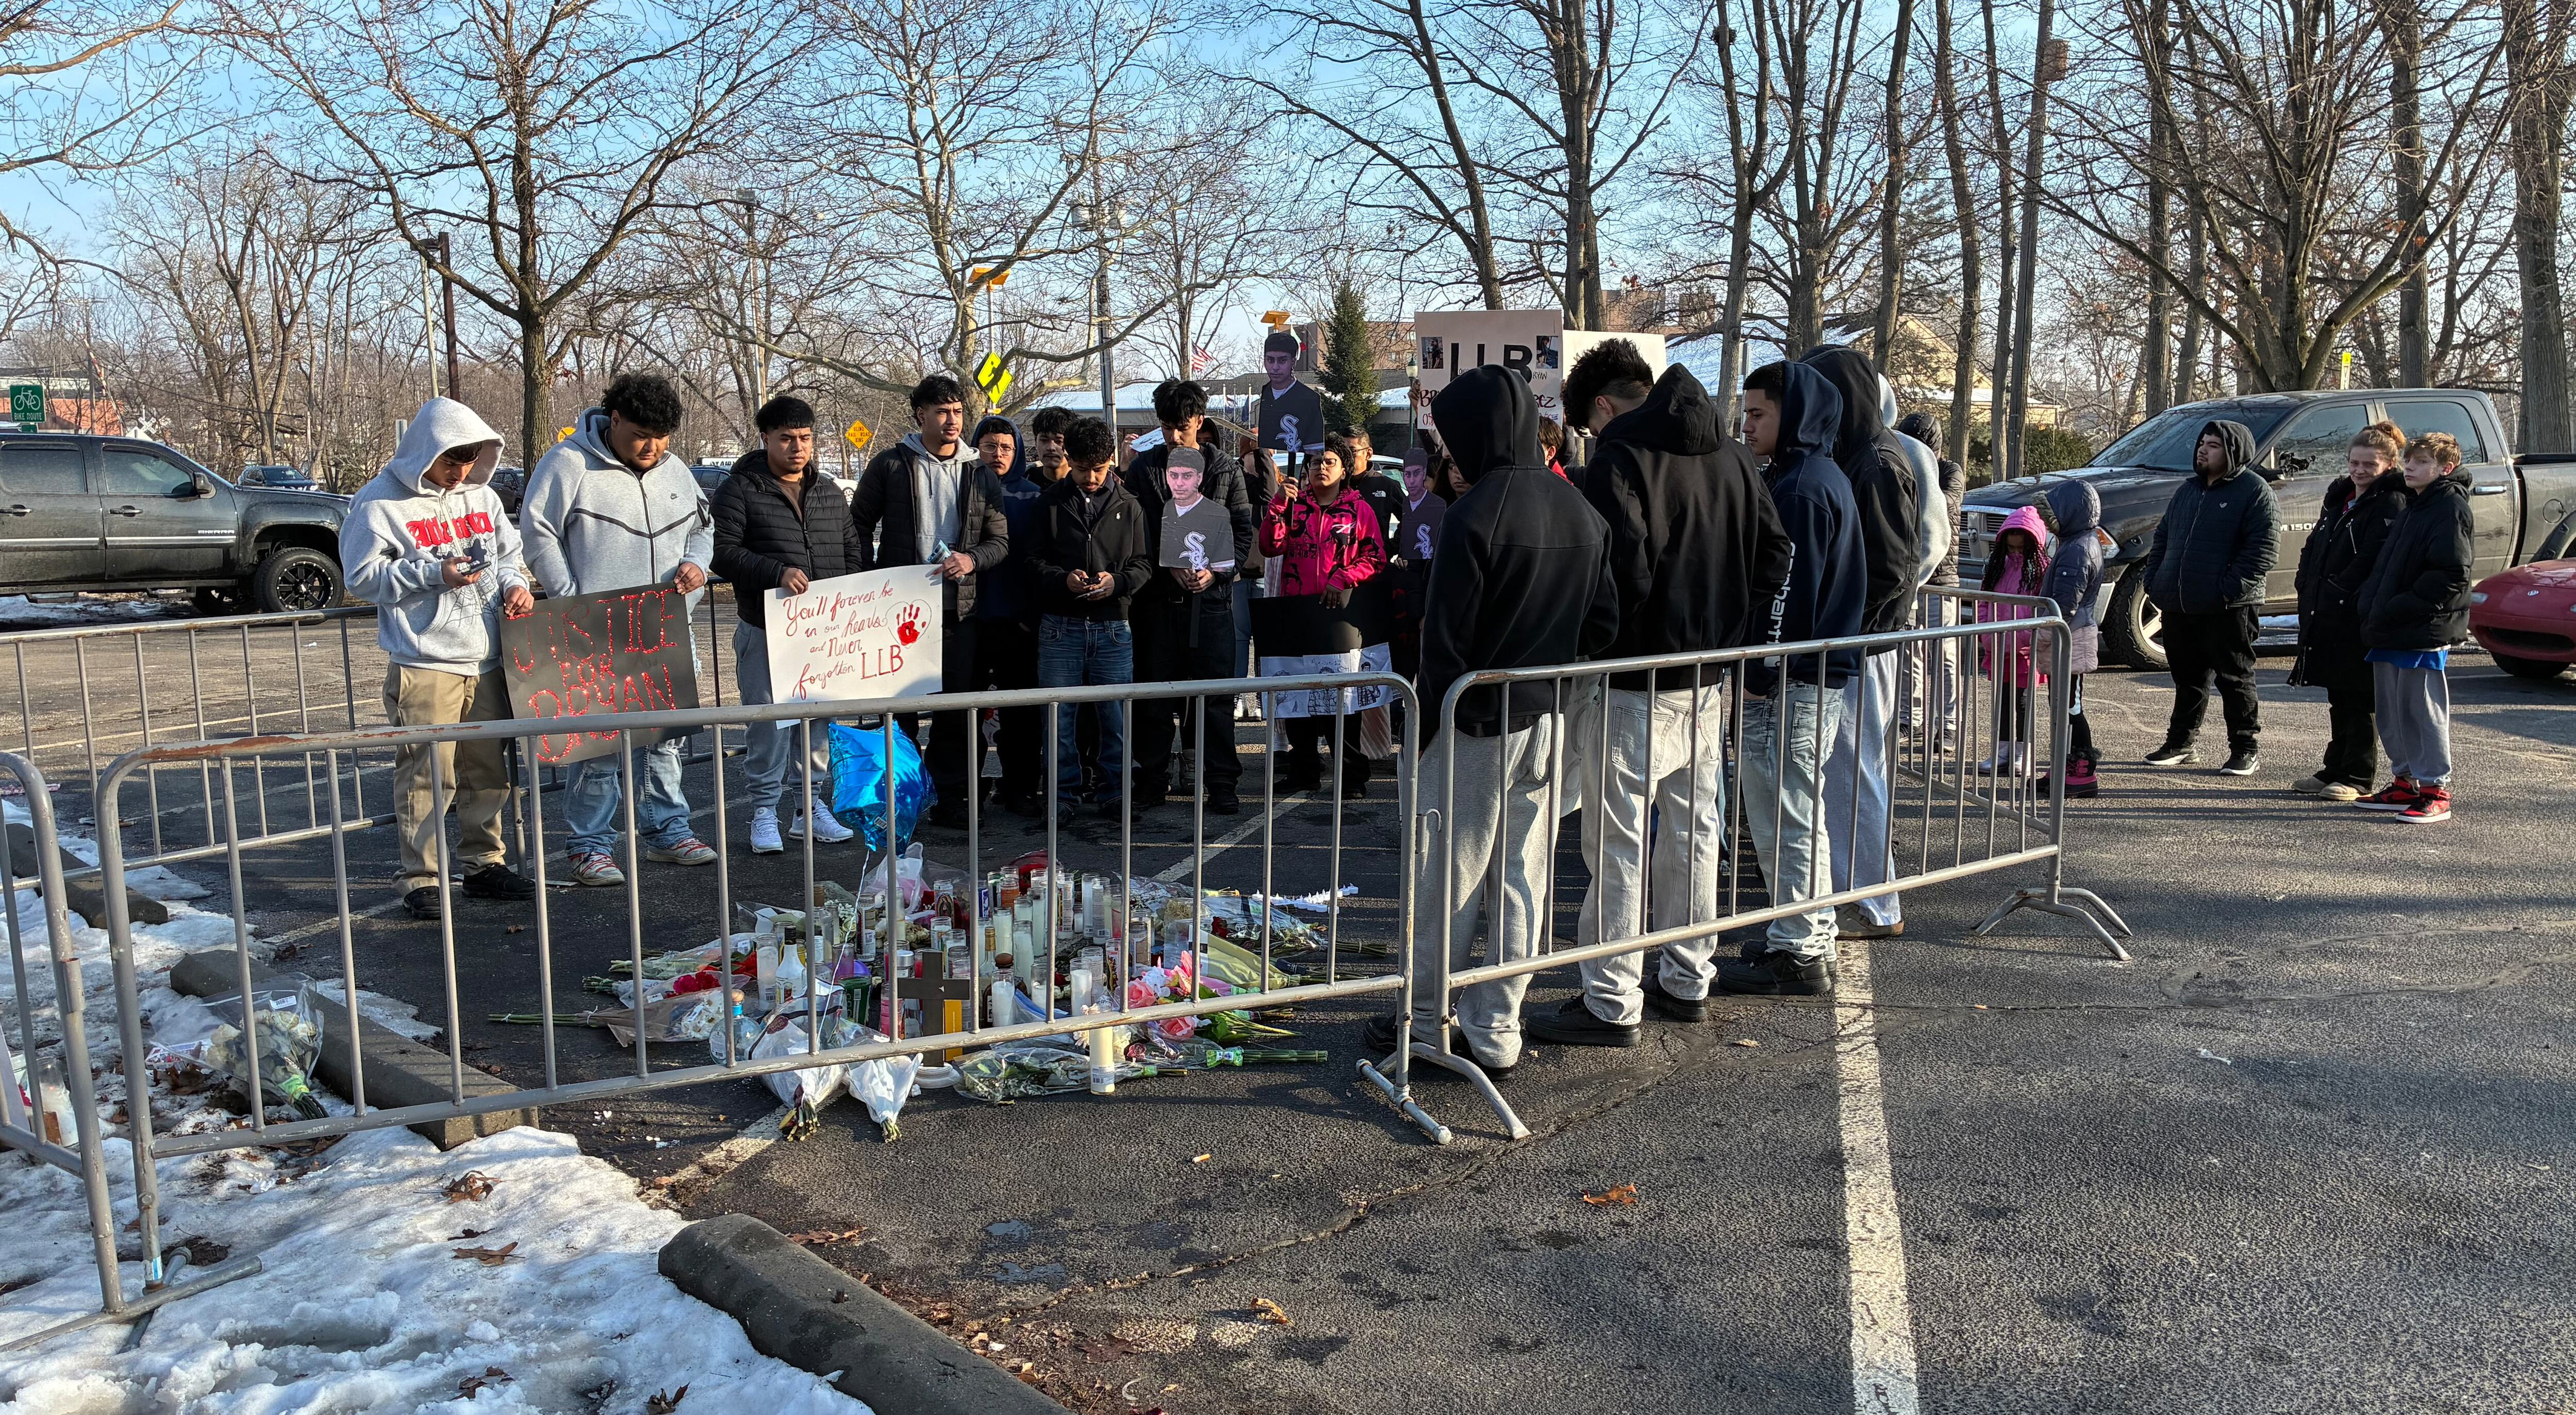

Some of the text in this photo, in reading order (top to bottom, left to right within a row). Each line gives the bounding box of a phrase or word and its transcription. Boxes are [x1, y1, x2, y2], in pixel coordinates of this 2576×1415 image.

[783, 579, 893, 637] You'll forever be
[804, 606, 885, 638] in our hearts
[809, 641, 827, 653] and
[861, 644, 904, 680] LLB
[558, 653, 616, 687] FOR
